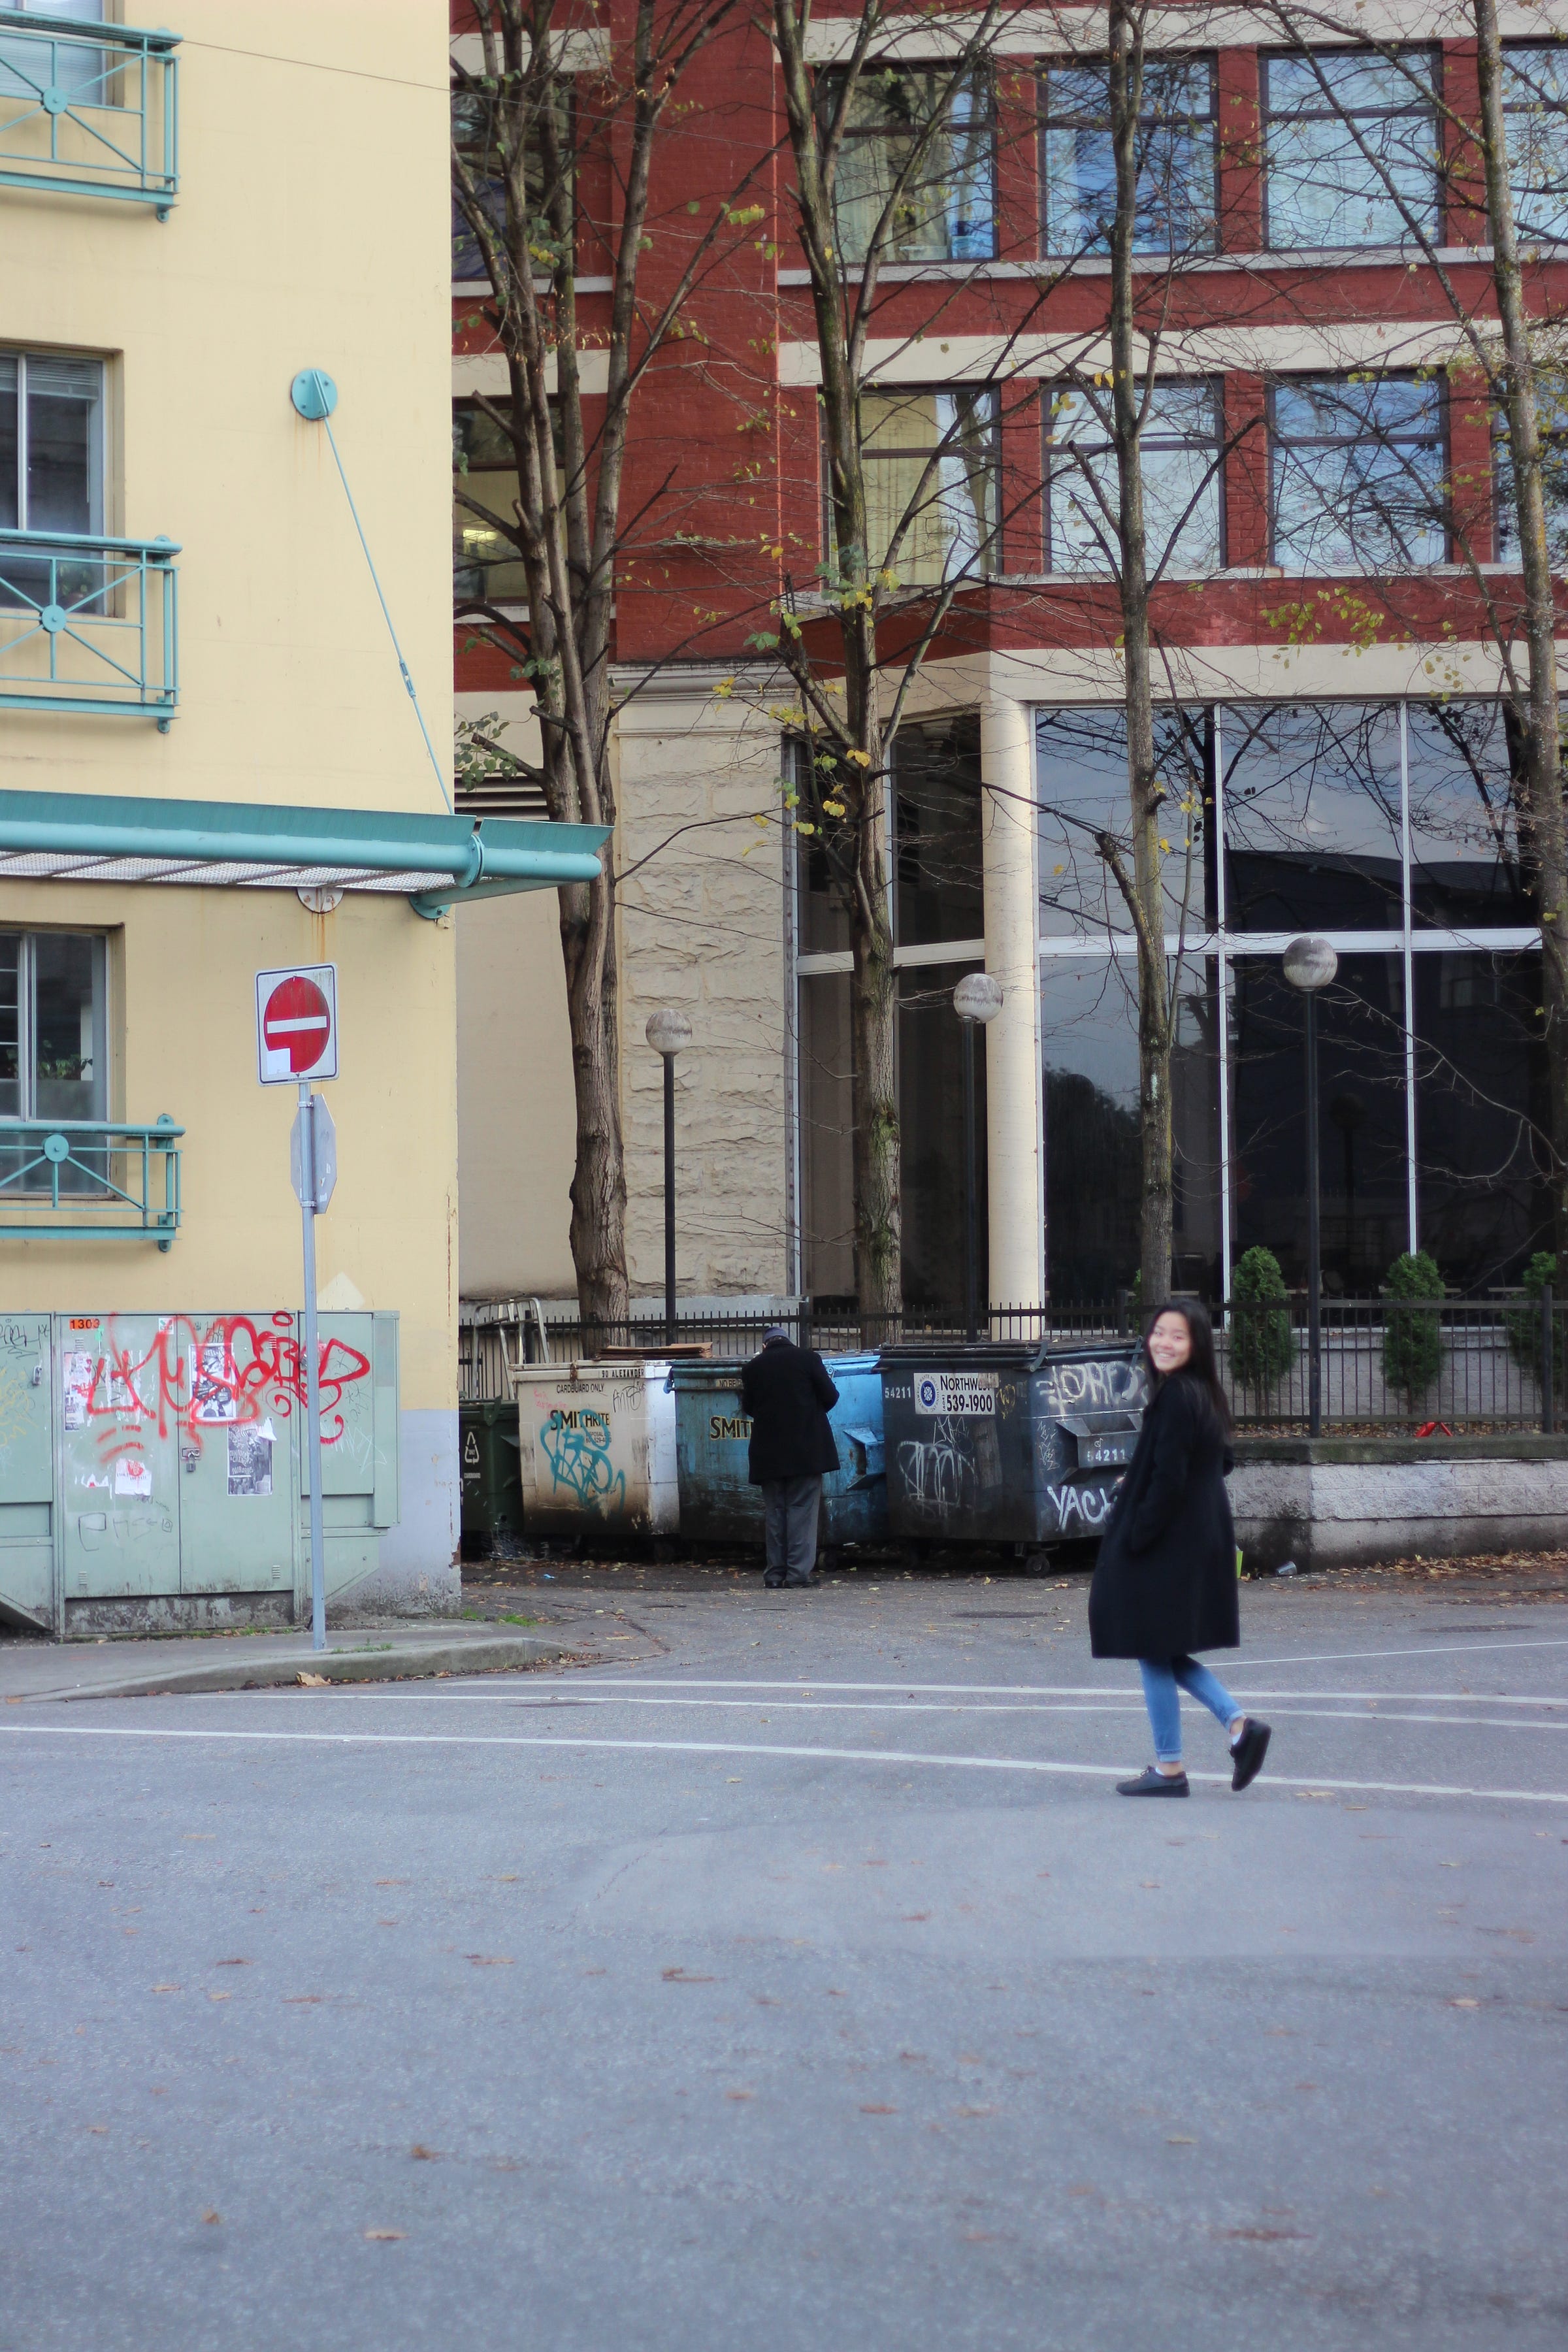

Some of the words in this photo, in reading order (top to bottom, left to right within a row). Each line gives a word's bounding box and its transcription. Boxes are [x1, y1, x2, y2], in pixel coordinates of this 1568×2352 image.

[71, 1318, 99, 1330] 1303
[612, 1368, 645, 1378] ALEXANDER
[556, 1384, 589, 1394] CARDBOARD
[590, 1383, 604, 1393] ONLY
[940, 1375, 990, 1391] NORTHW
[885, 1386, 911, 1399] 54211
[947, 1394, 992, 1412] 539-1900
[549, 1409, 610, 1431] SMIHRITE
[710, 1415, 753, 1440] SMIT
